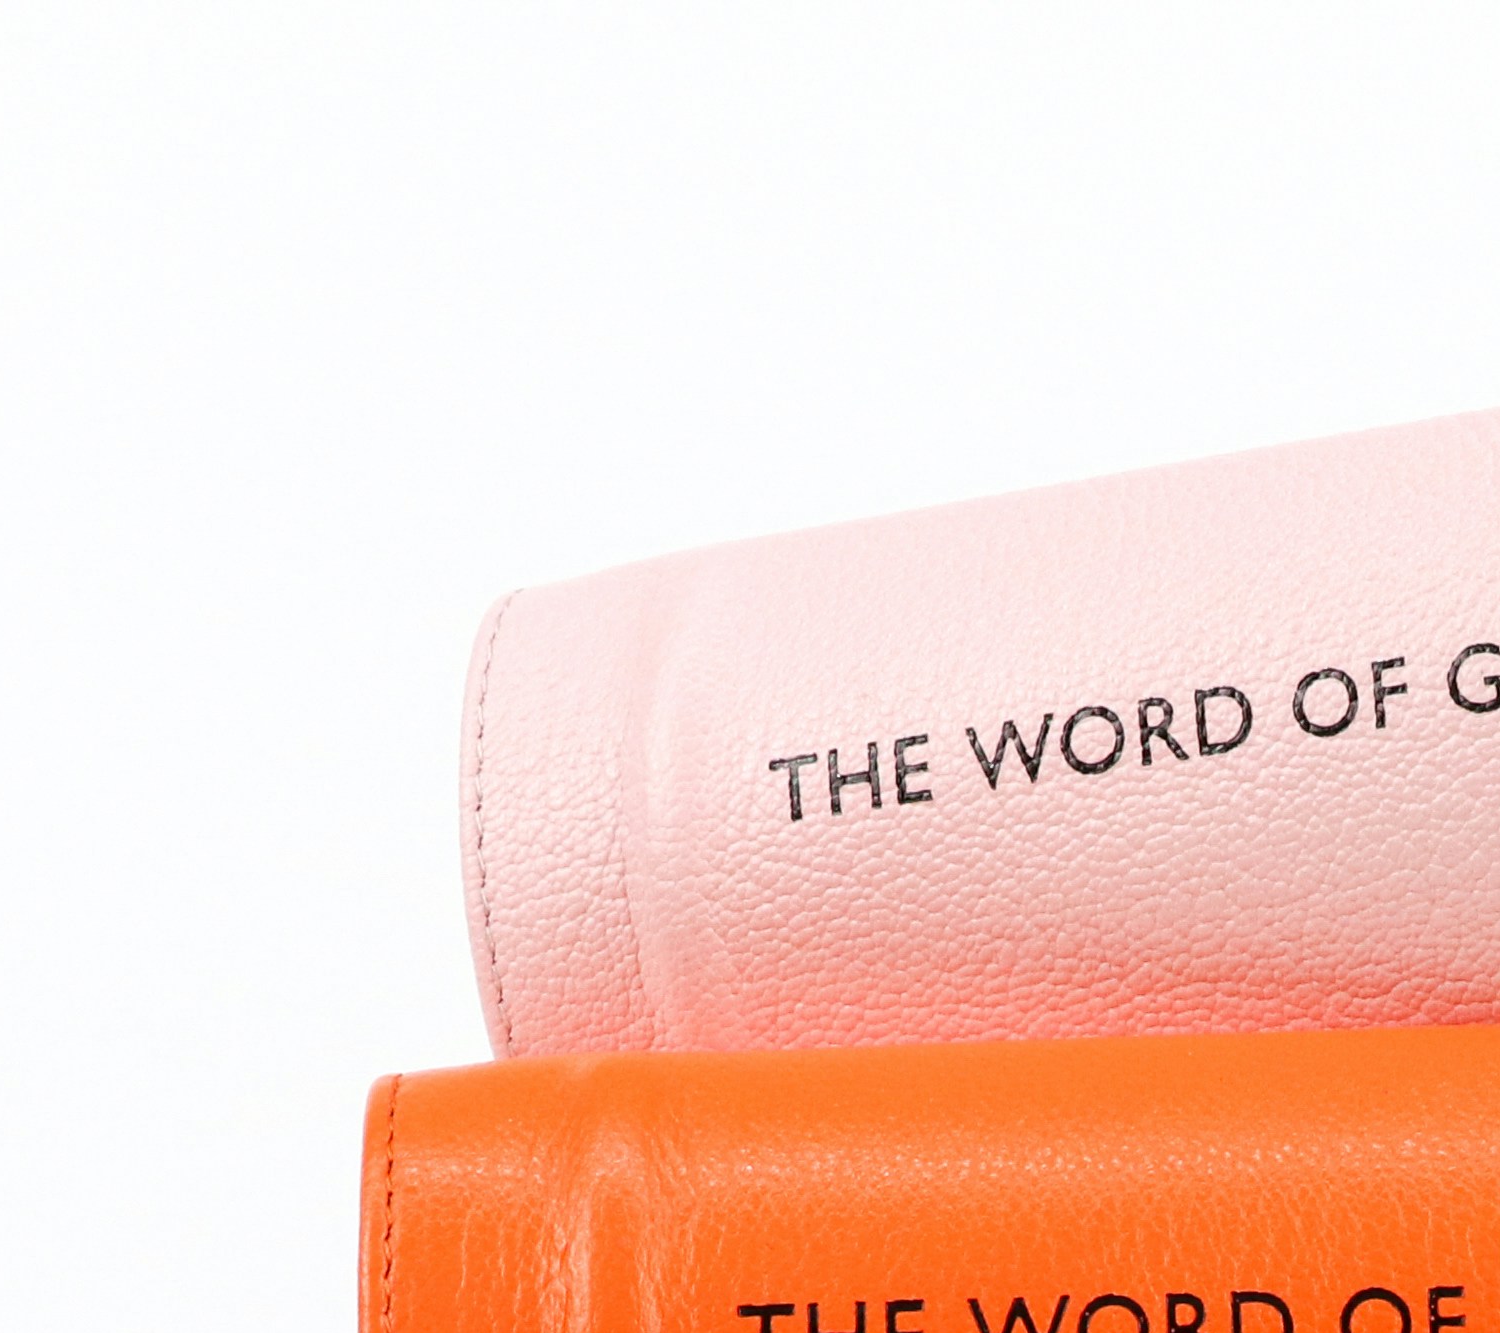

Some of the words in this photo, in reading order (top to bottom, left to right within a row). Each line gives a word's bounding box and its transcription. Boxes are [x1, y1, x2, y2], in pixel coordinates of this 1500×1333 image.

[769, 732, 933, 823] THE
[963, 685, 1254, 790] WORD
[1291, 655, 1408, 739] OF
